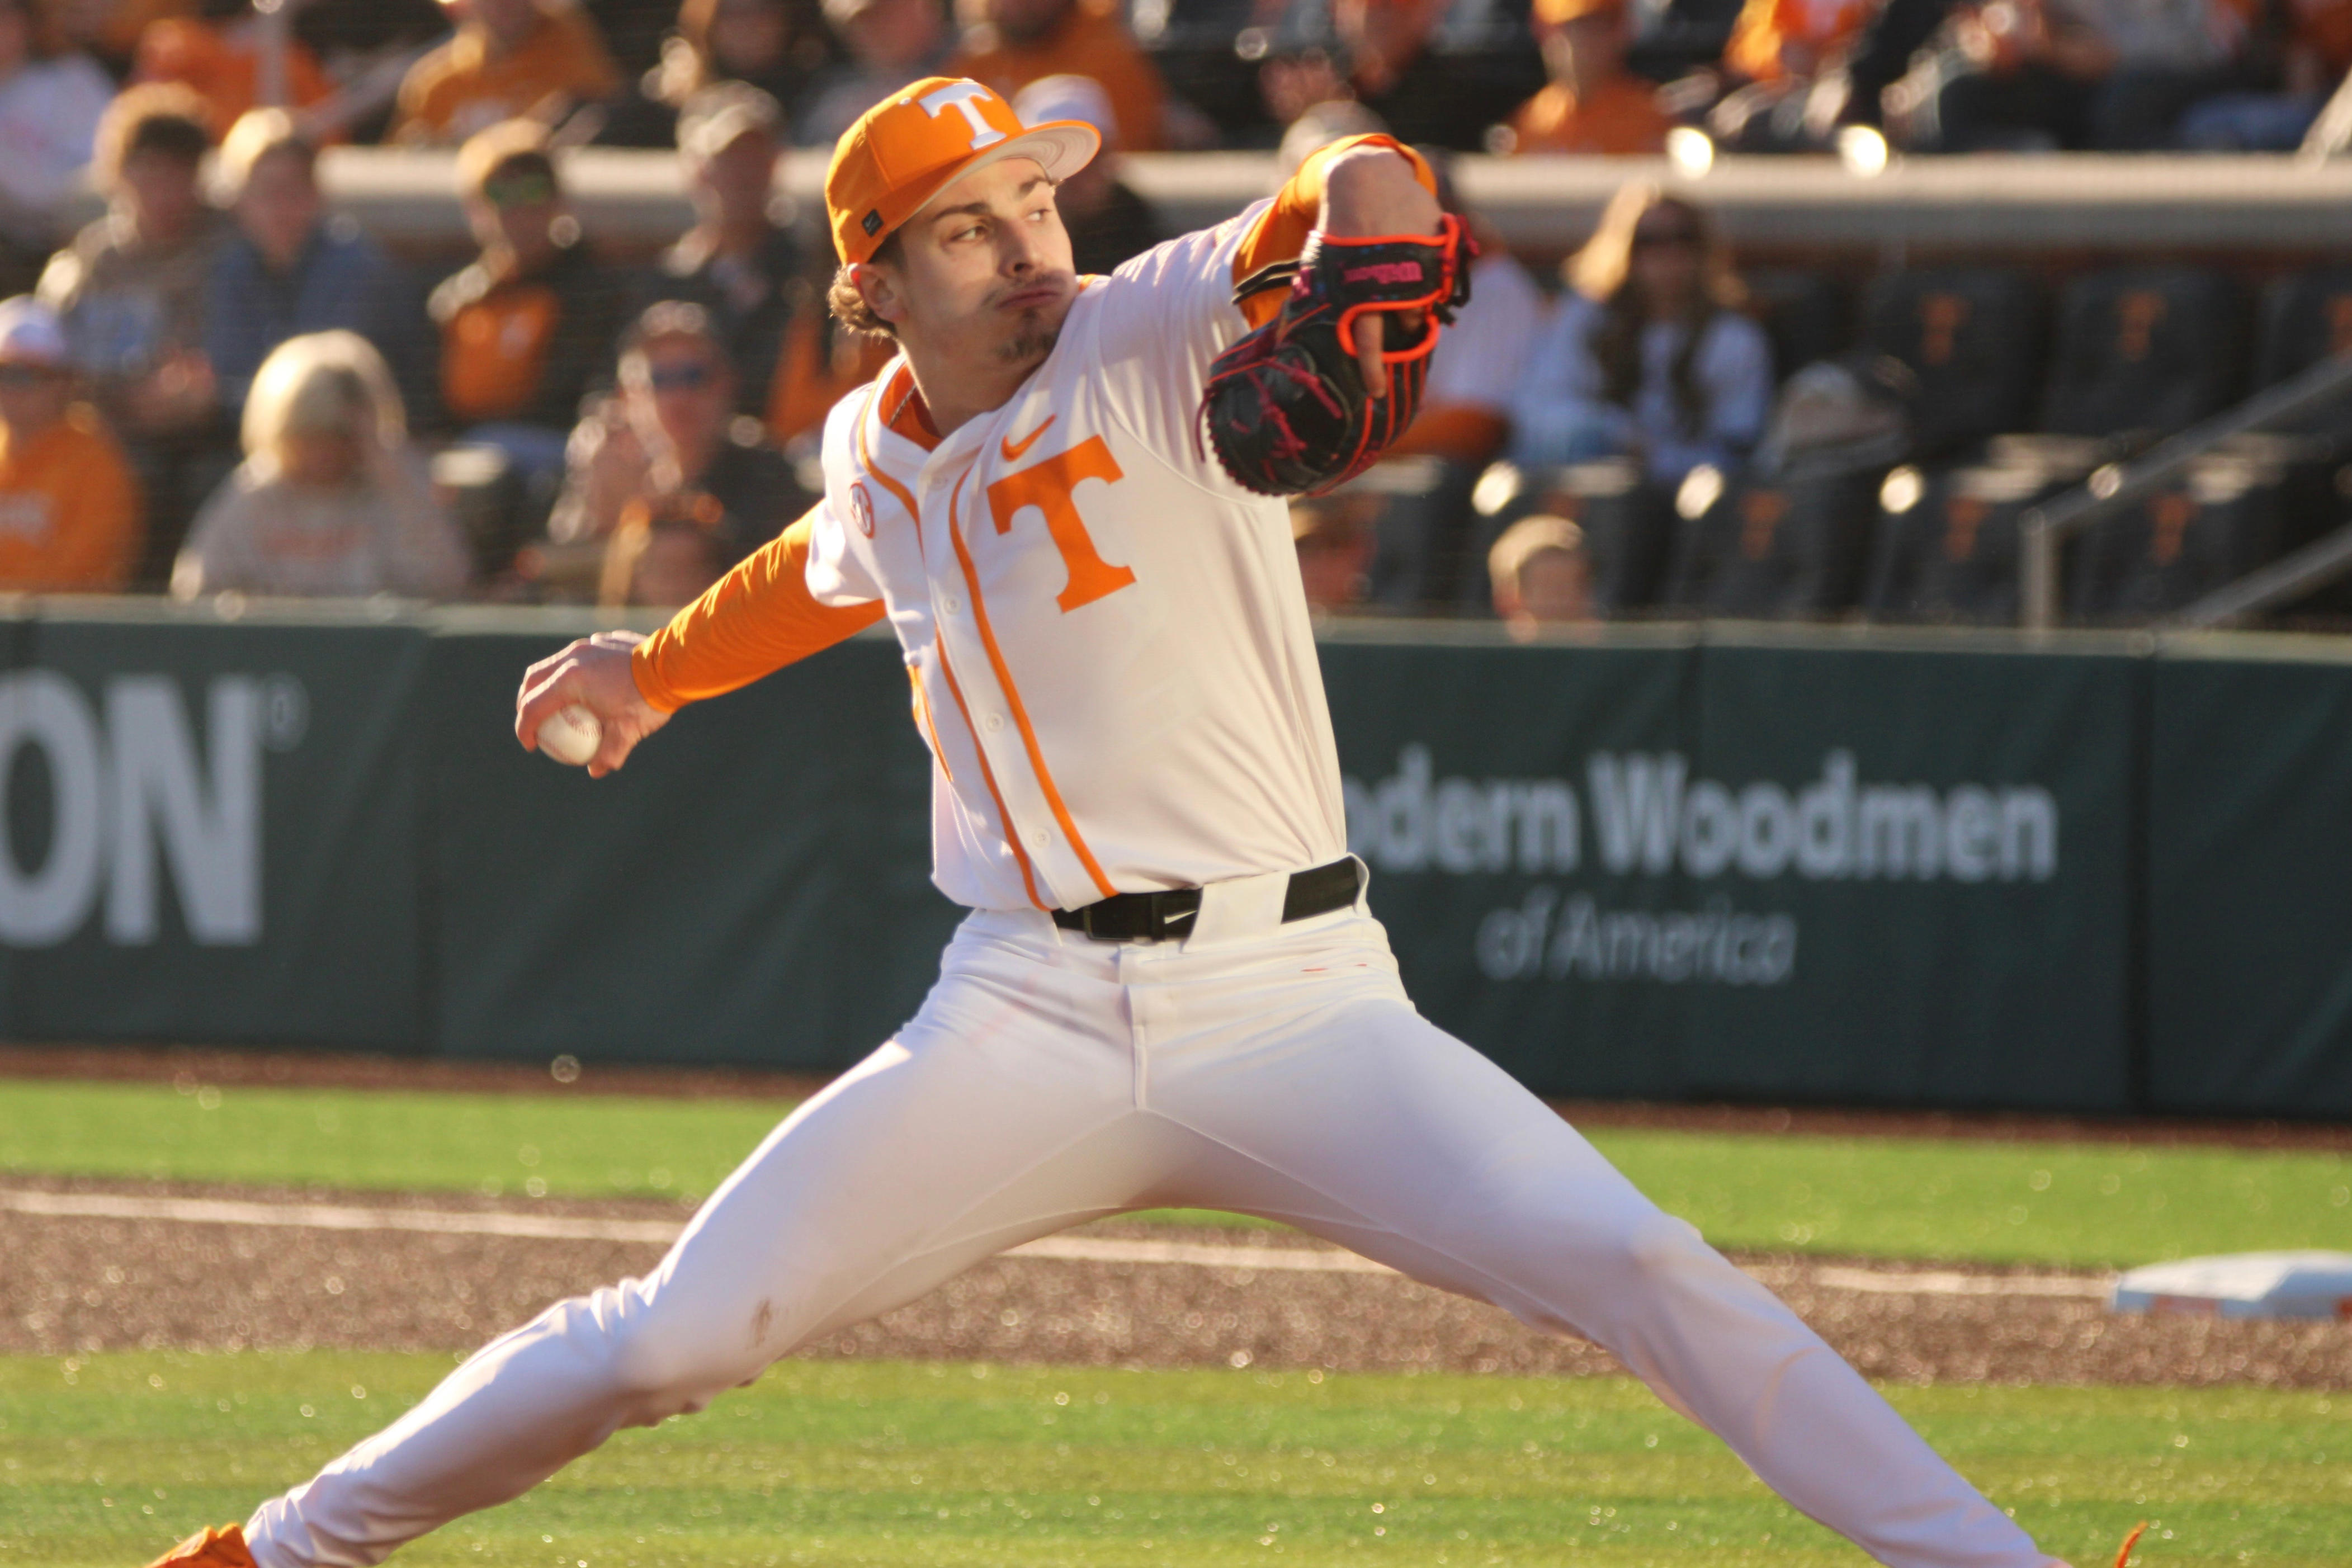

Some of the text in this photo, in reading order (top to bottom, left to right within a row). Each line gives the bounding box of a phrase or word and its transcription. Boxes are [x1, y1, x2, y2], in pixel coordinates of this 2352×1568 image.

[918, 82, 1007, 150] T
[986, 434, 1136, 613] T
[1587, 749, 2058, 881] Woodmen
[1477, 886, 1796, 985] of America
